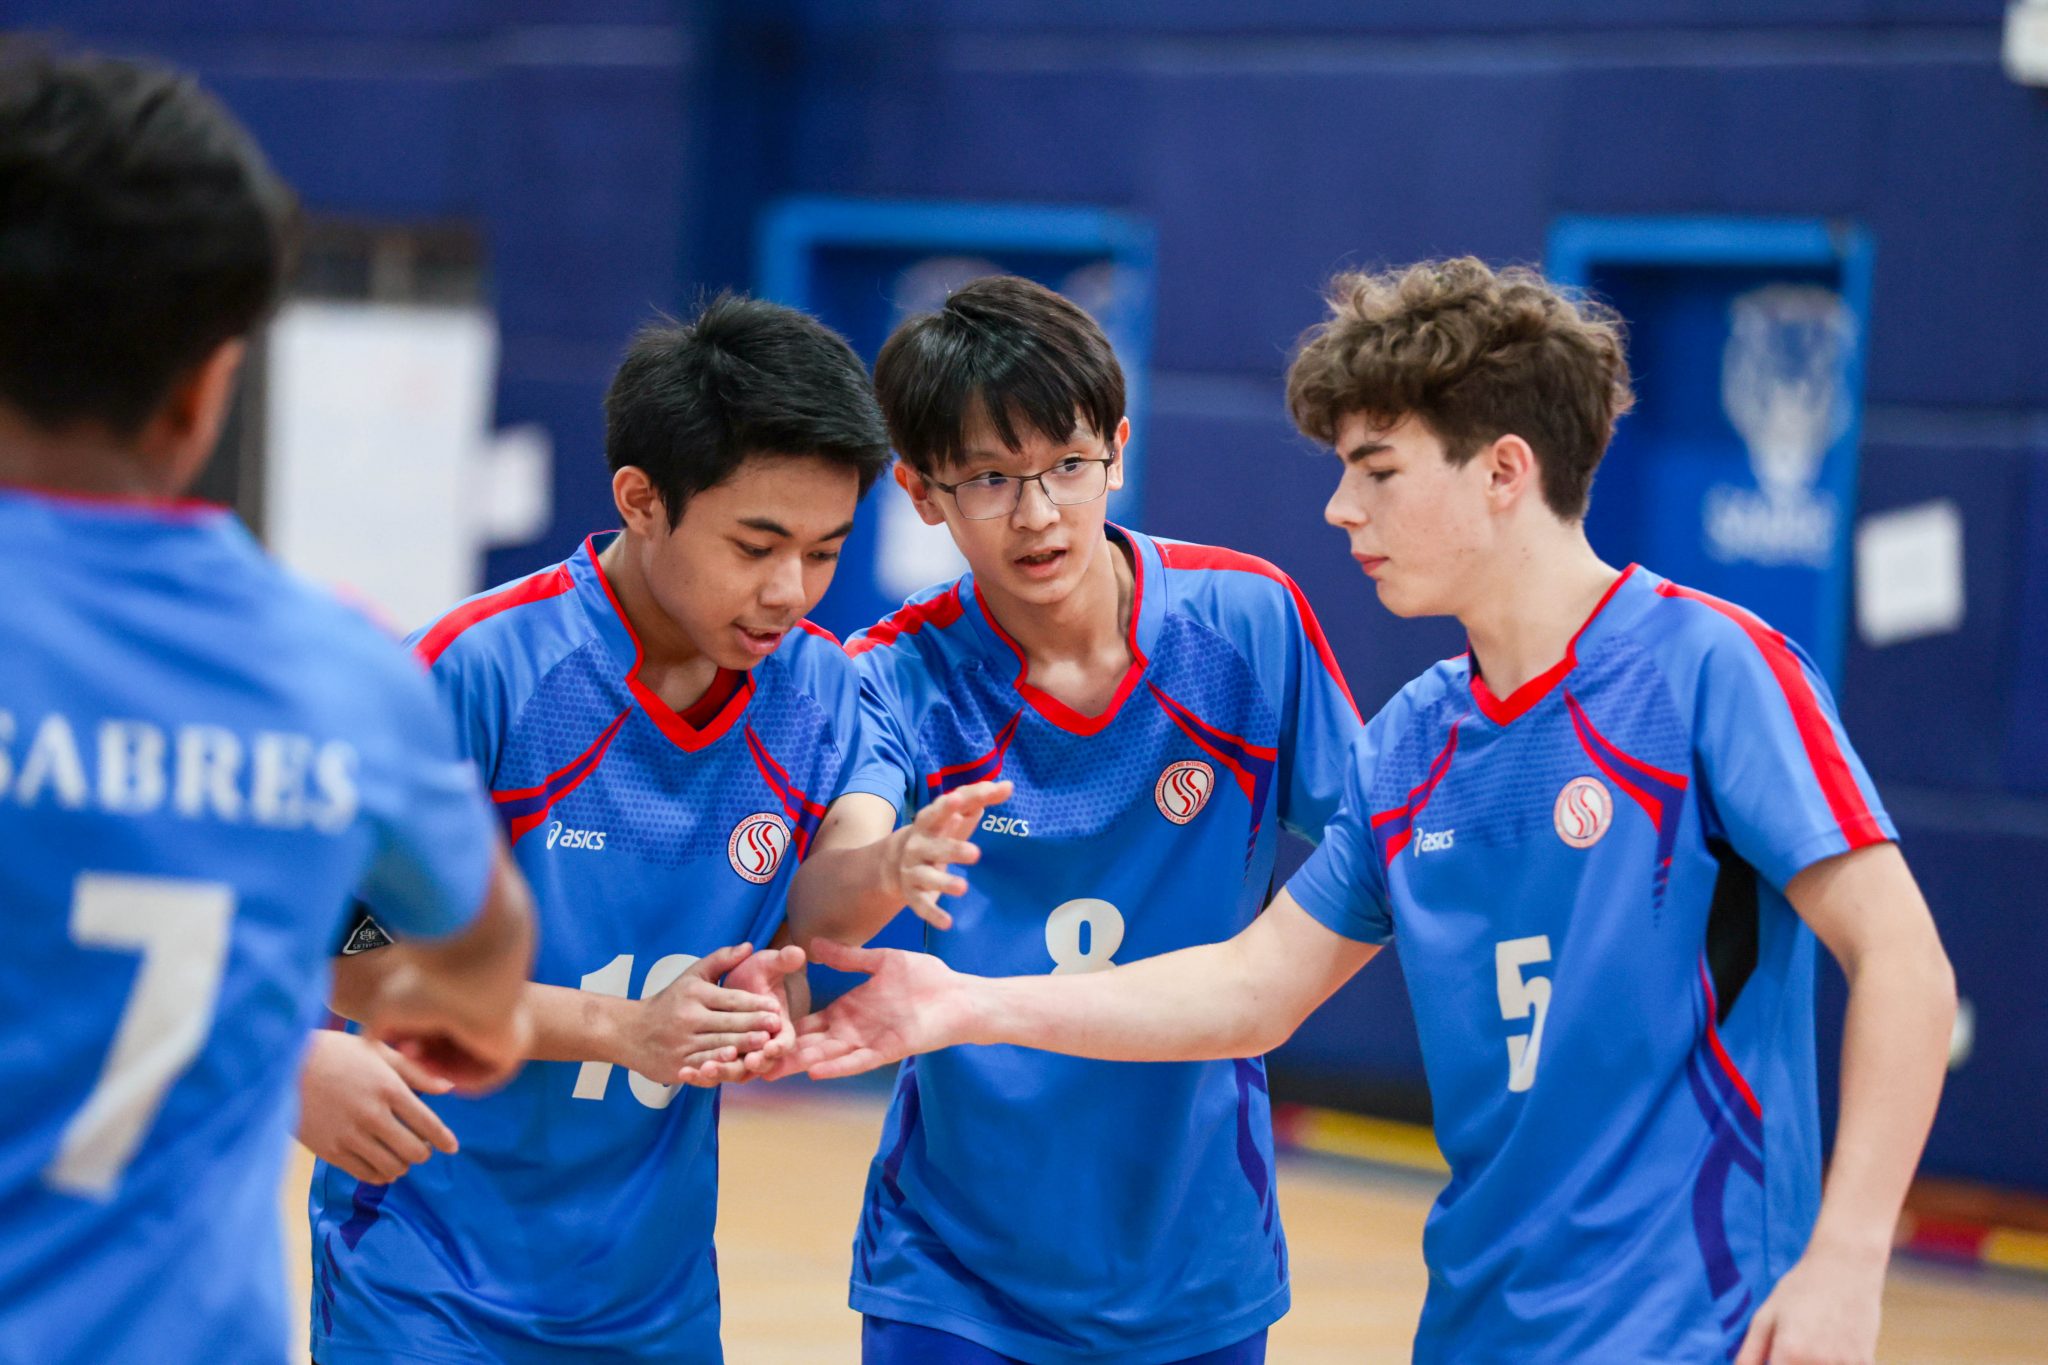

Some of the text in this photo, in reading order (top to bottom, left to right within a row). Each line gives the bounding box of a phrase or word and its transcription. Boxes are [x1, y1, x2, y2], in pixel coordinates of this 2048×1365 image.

[560, 828, 607, 851] asics
[982, 814, 1030, 838] asics
[44, 869, 237, 1202] 7
[1495, 935, 1552, 1092] 5
